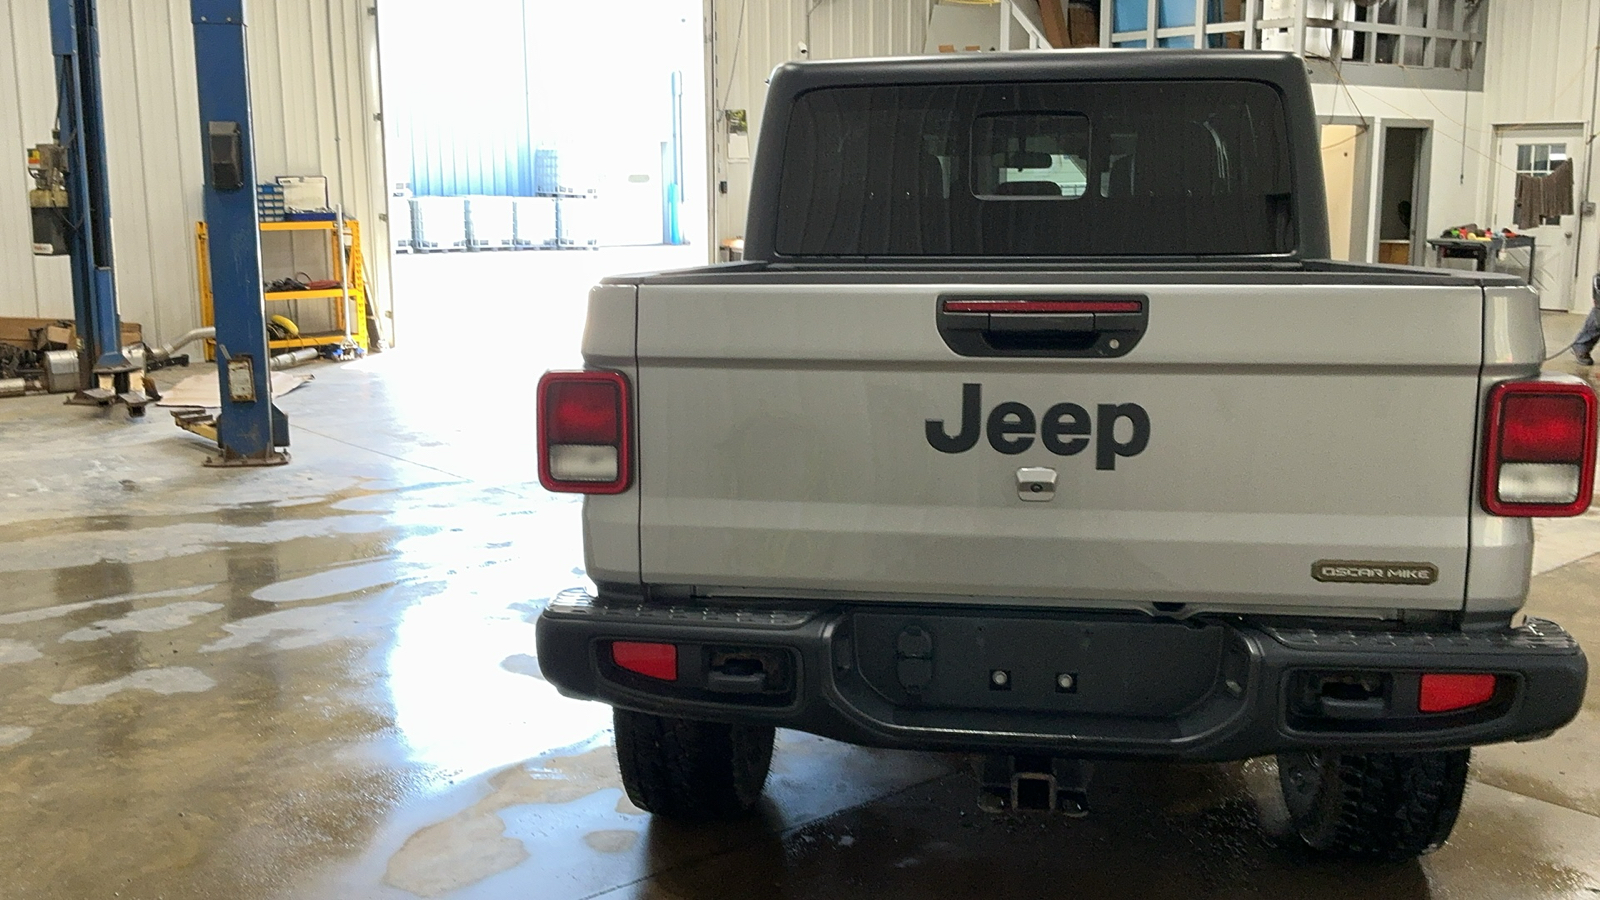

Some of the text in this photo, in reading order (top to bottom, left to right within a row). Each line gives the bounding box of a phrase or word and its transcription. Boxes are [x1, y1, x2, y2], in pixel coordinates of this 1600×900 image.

[925, 383, 1150, 470] Jeep
[1322, 566, 1430, 579] OSCAR MIKE
